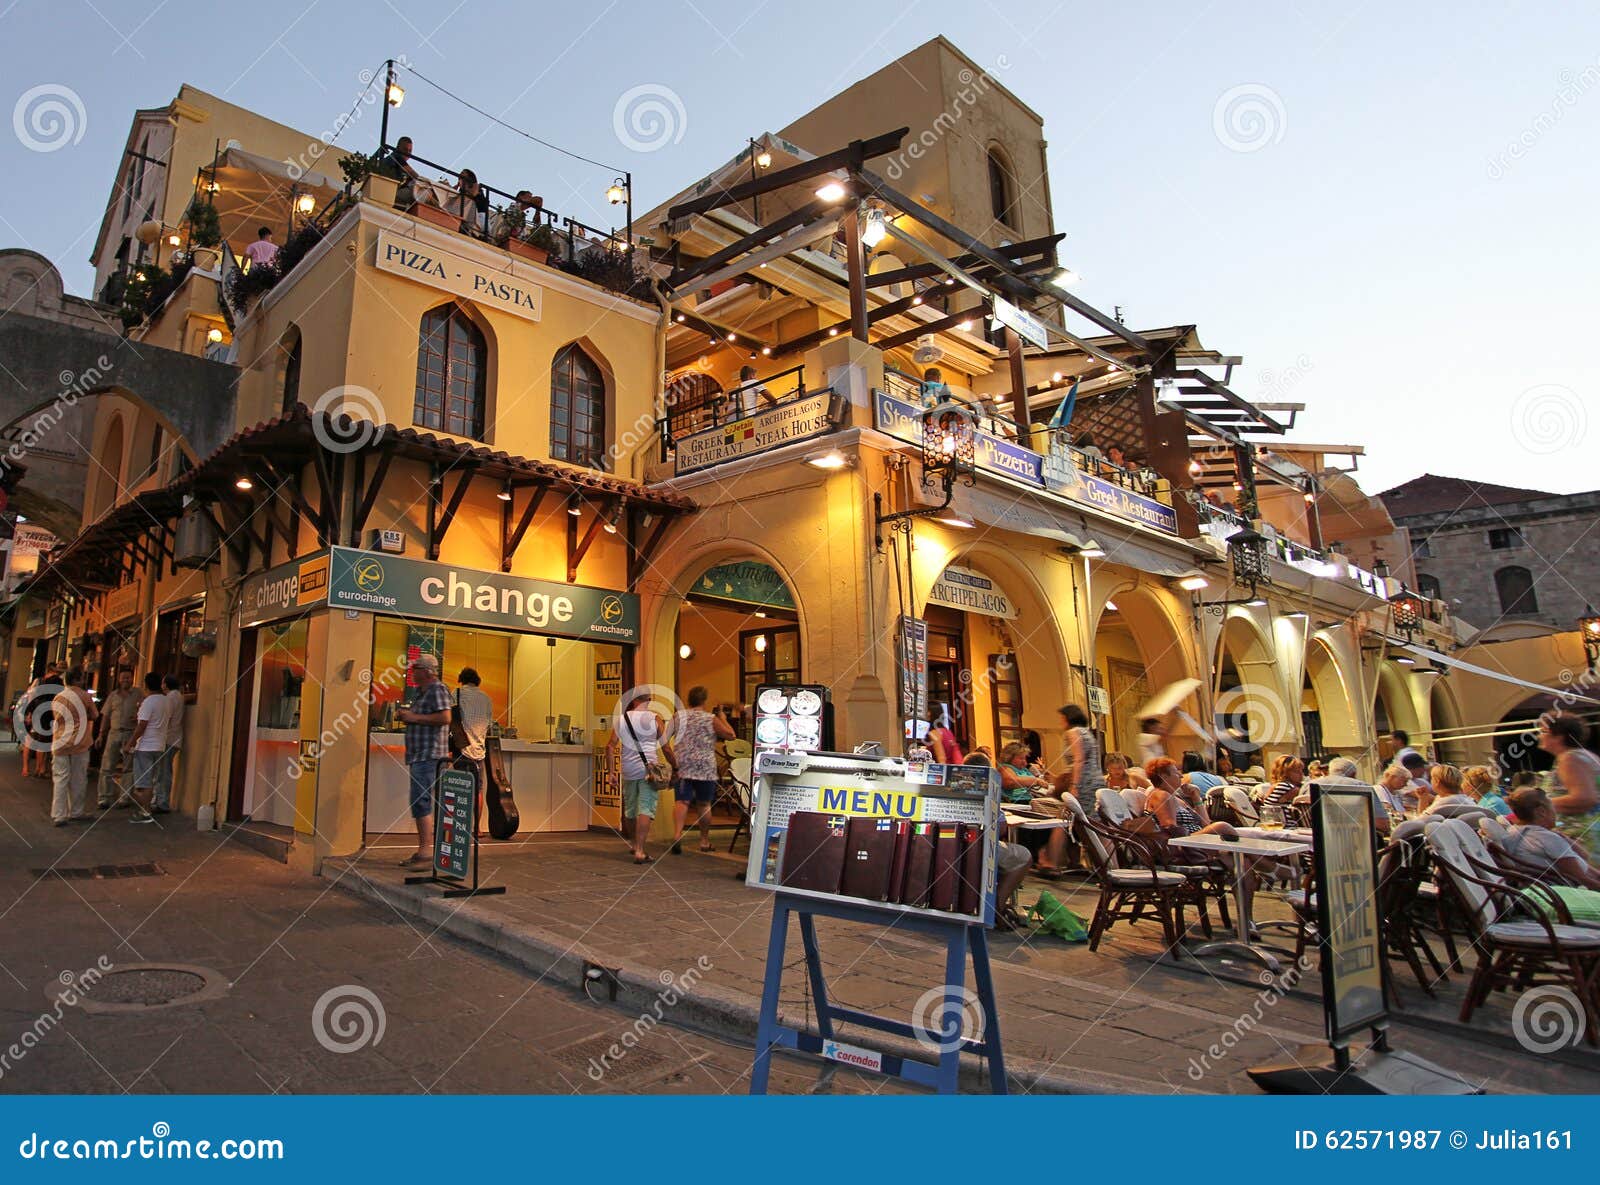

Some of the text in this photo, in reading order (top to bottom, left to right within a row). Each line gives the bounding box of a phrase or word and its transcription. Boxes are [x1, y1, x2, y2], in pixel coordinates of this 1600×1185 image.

[386, 244, 446, 279] PIZZA
[474, 274, 535, 310] PASTA
[759, 400, 822, 428] ARCHIPELAGOS
[691, 434, 723, 453] GREEK
[755, 414, 828, 447] STEAK HOUSE
[680, 442, 744, 468] RESTAURANT
[982, 438, 1036, 478] Pizzeria
[1086, 480, 1175, 532] Greek Restaurant
[257, 575, 298, 608] change
[338, 590, 397, 606] eurochange
[420, 572, 573, 627] change
[930, 583, 1007, 613] ARCHIPELAGOS
[590, 623, 633, 636] eurochange
[823, 788, 917, 817] MENU
[837, 1050, 880, 1069] corendon
